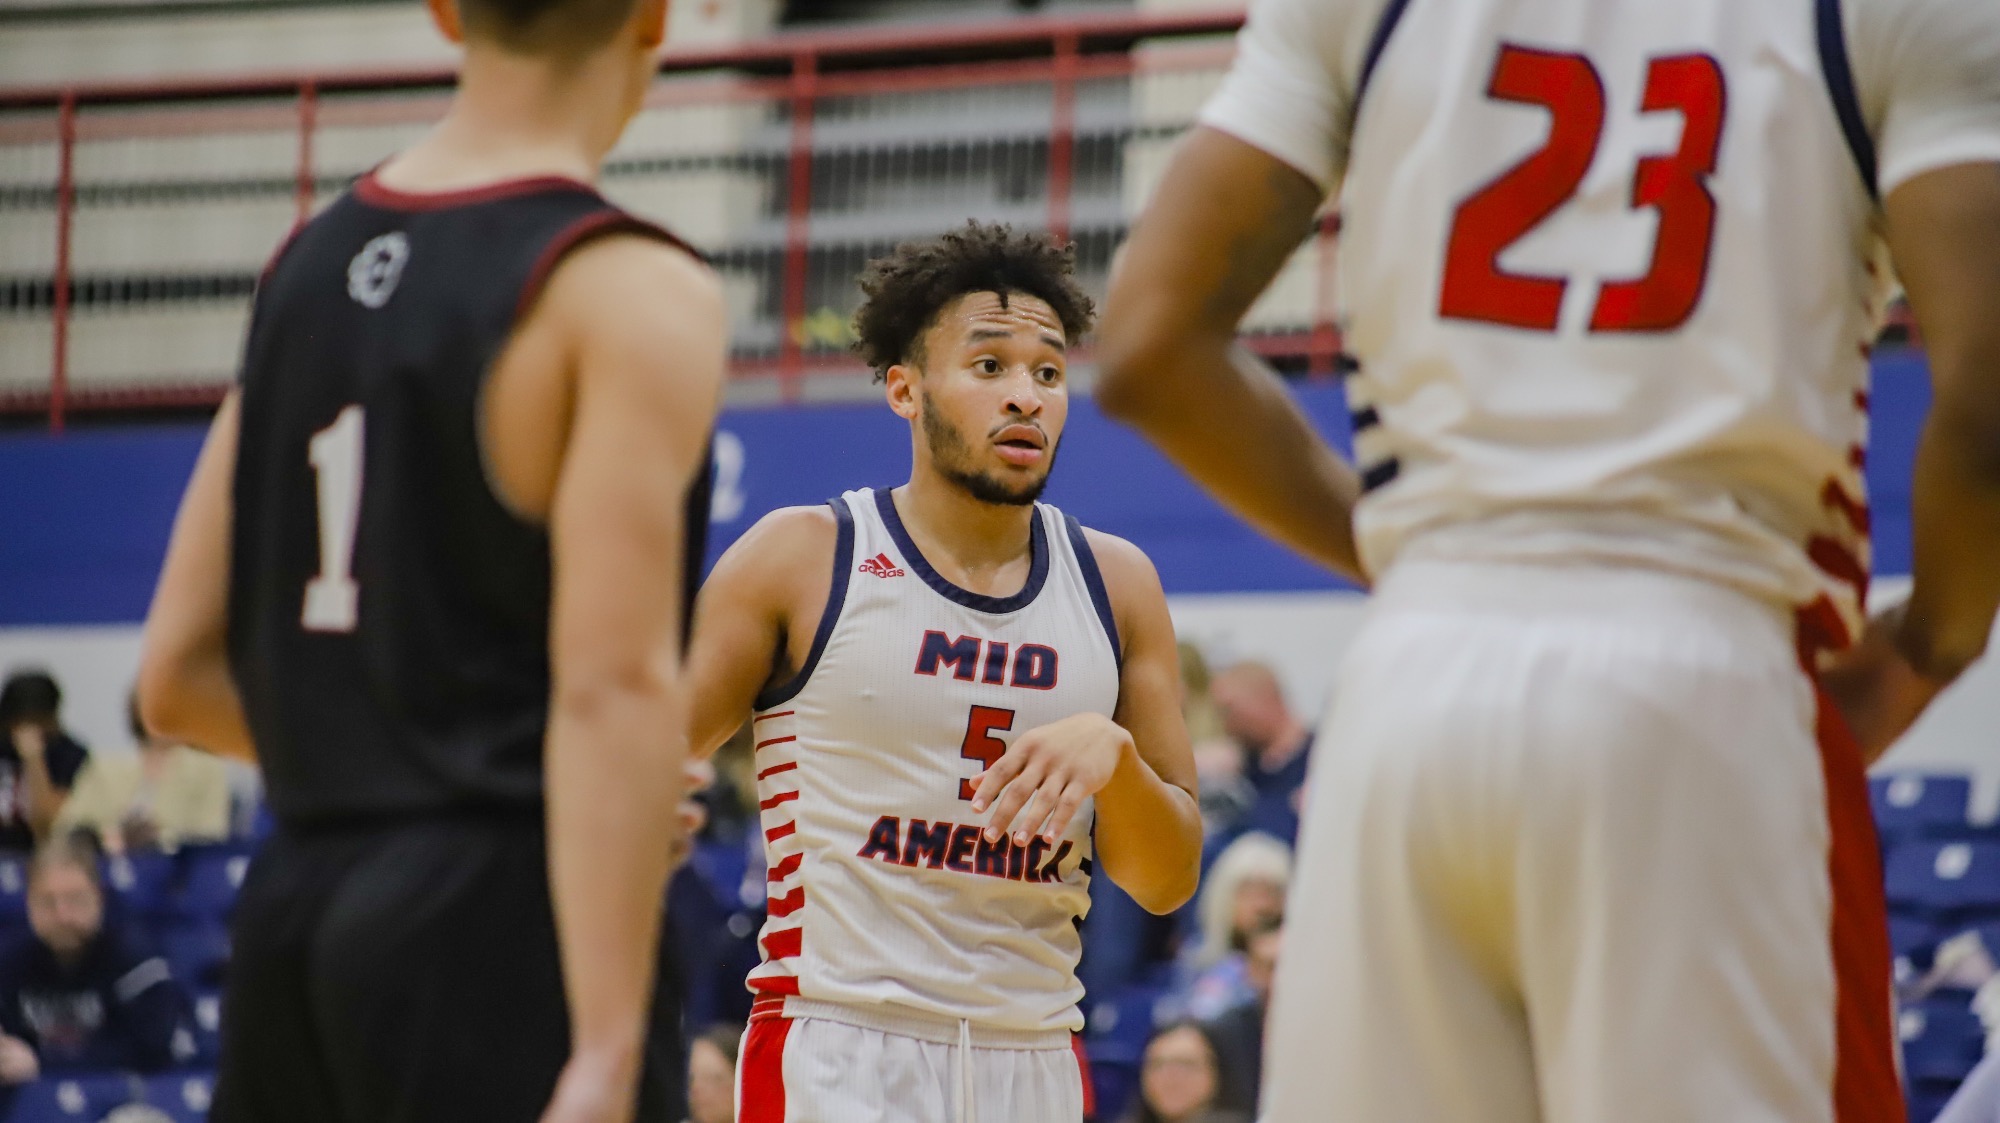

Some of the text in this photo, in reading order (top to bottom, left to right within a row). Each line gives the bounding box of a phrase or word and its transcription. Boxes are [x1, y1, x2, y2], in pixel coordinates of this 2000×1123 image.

[1438, 40, 1726, 333] 23
[301, 403, 367, 632] 1
[858, 564, 905, 579] addas
[914, 630, 1058, 690] MID
[958, 704, 1015, 802] 5
